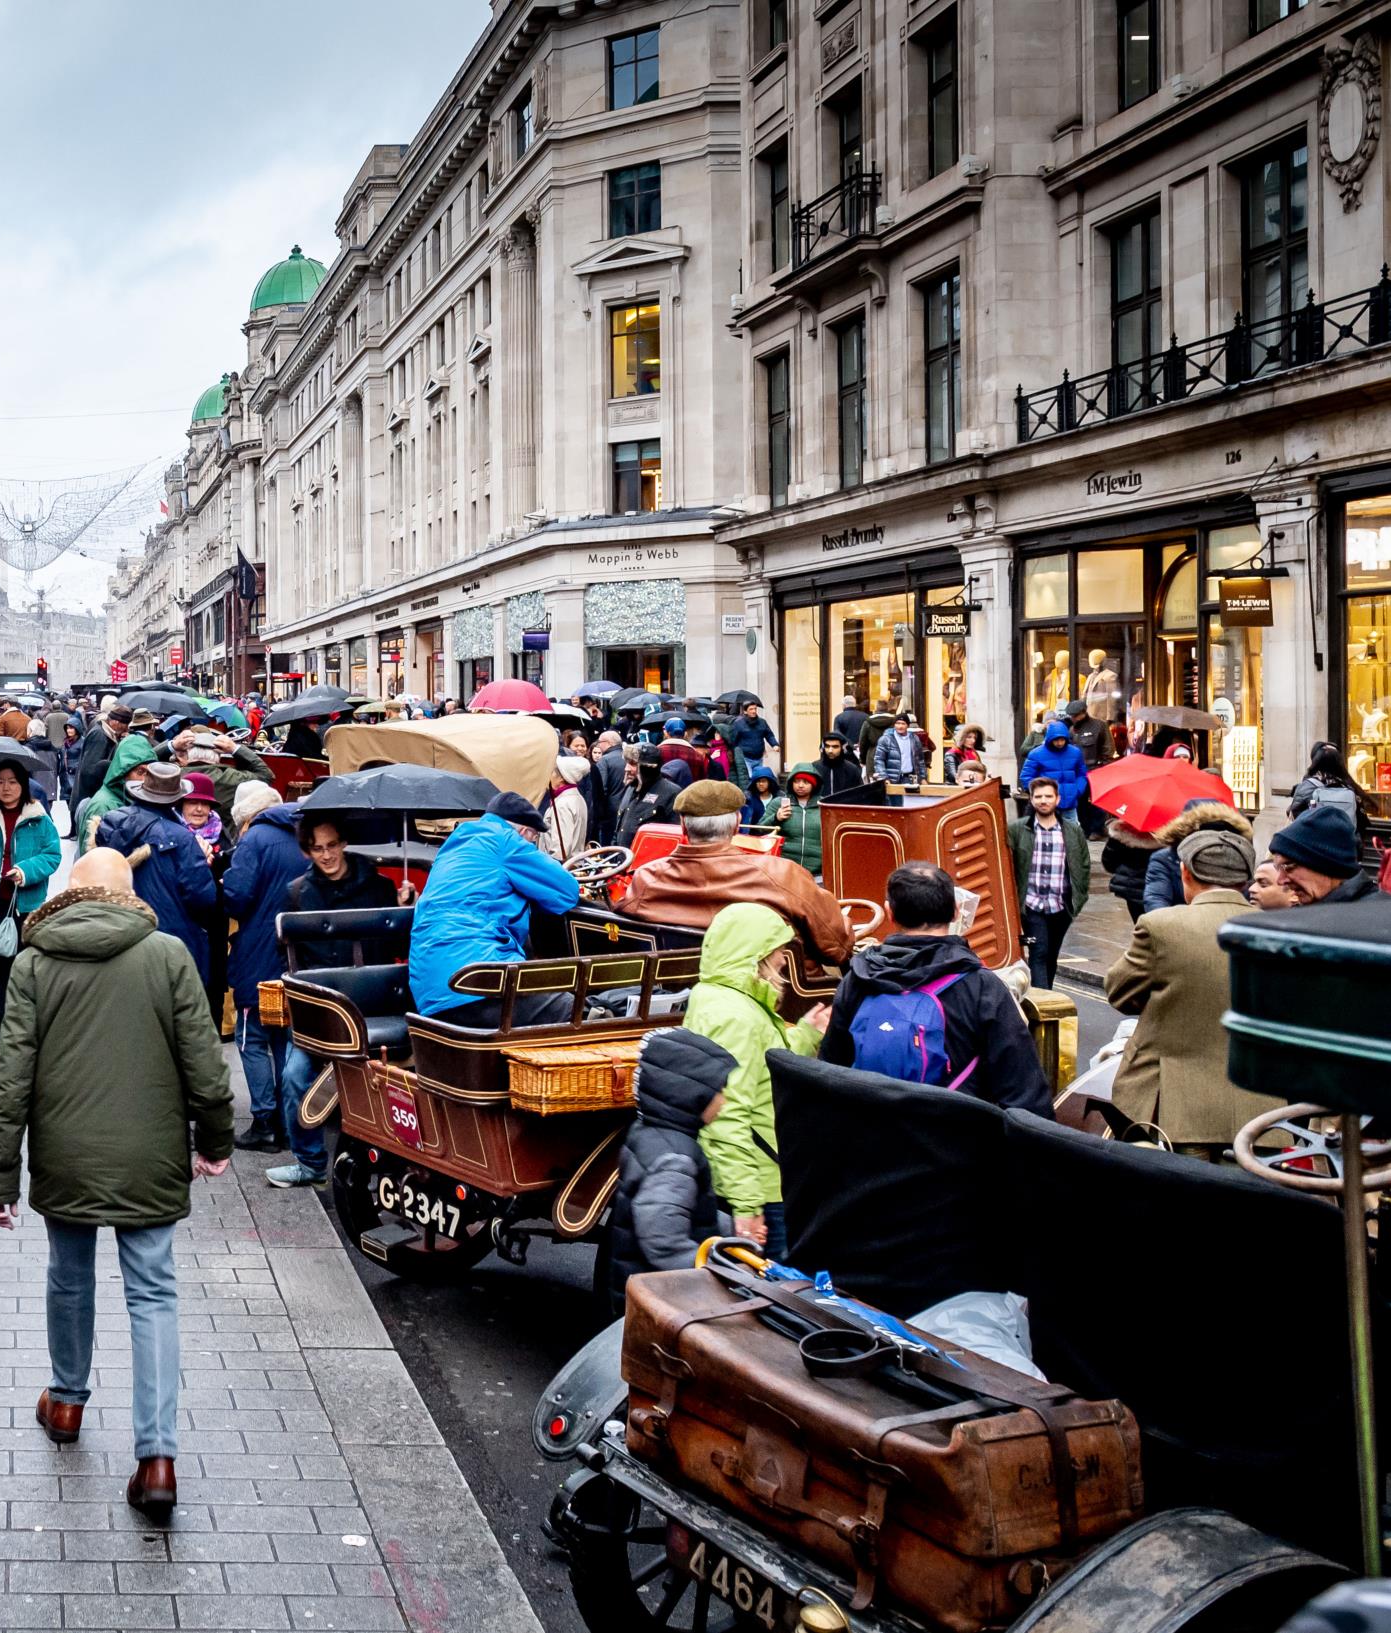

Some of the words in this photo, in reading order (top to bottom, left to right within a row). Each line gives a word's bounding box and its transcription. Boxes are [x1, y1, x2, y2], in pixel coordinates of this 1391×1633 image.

[1225, 449, 1242, 465] 126
[587, 551, 631, 566] Mappin
[635, 550, 643, 561] &
[646, 547, 679, 560] Webb
[931, 613, 964, 625] Russell
[391, 1105, 417, 1131] 359
[689, 1541, 776, 1631] 4464
